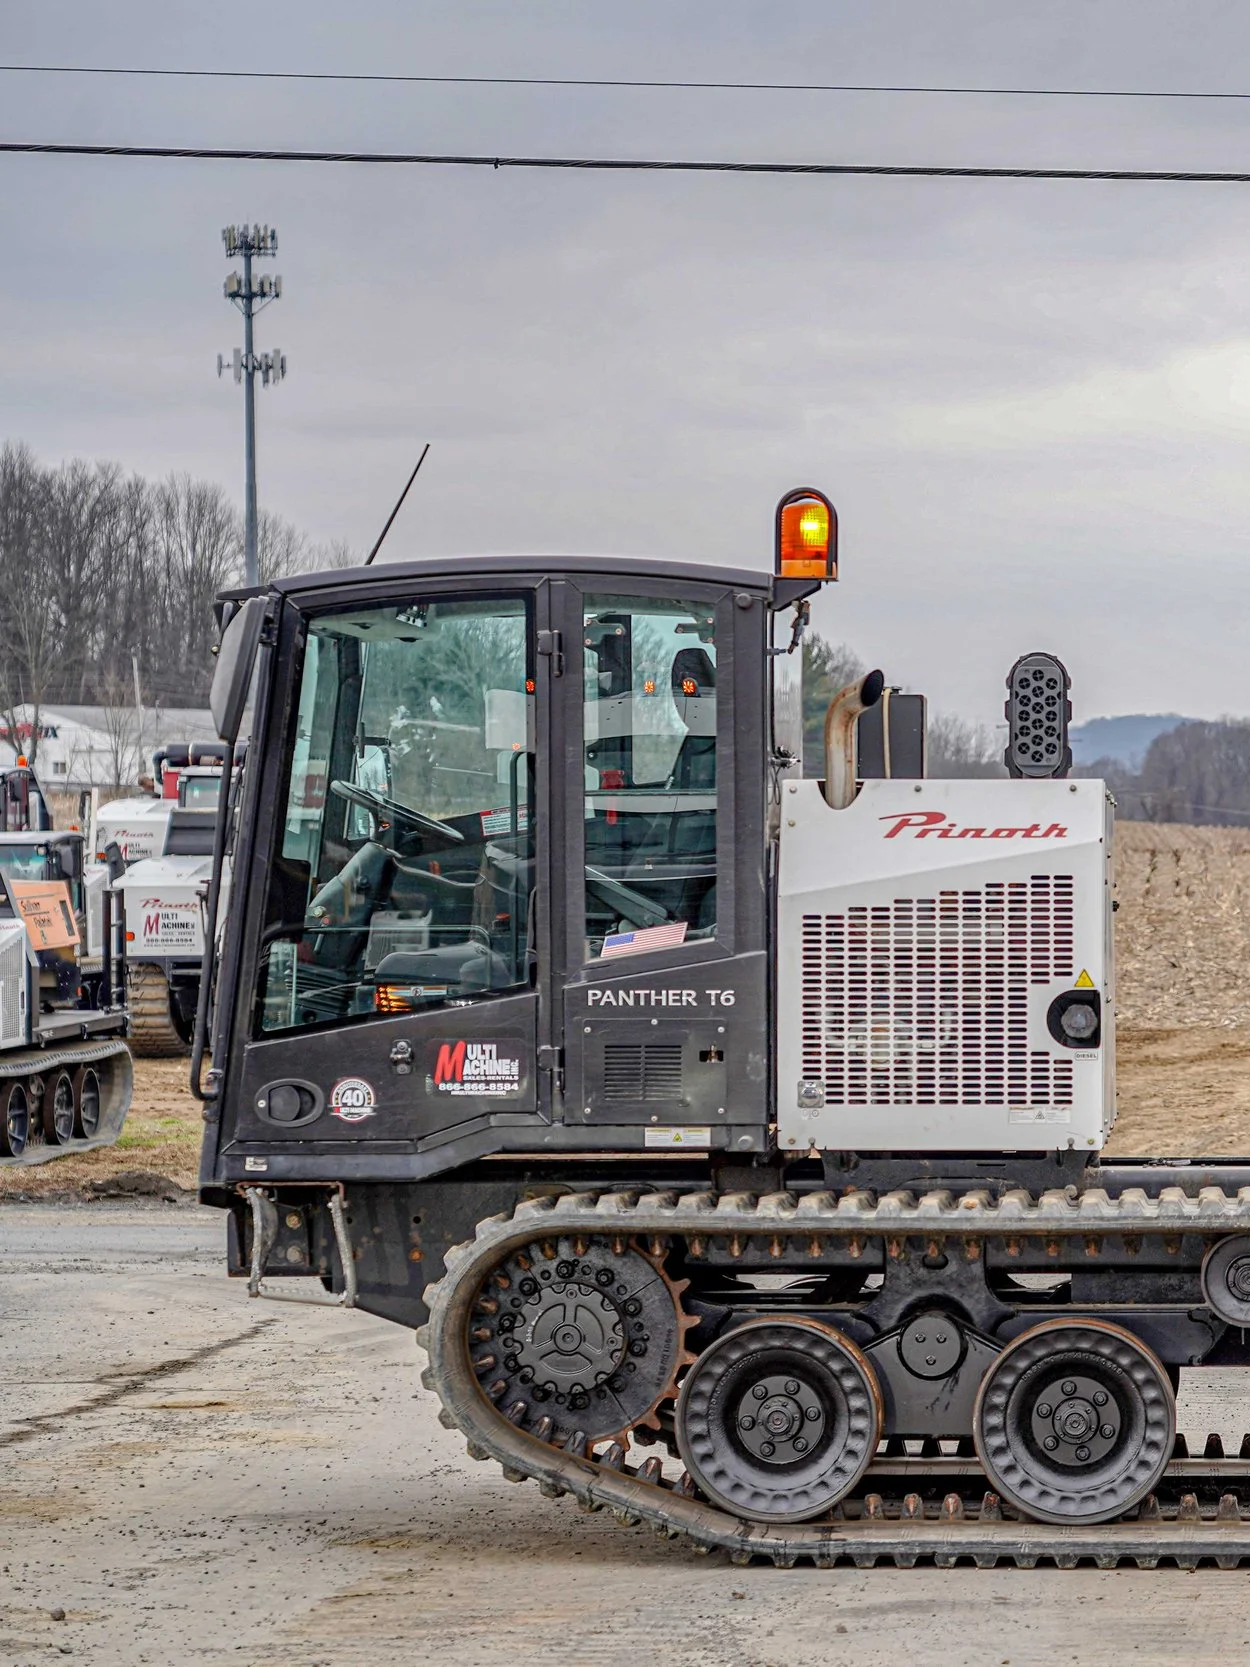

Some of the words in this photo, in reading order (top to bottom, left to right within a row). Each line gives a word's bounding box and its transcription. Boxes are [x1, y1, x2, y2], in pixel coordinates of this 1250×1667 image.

[878, 811, 1068, 838] Prinoth
[587, 989, 698, 1006] PANTHER
[705, 989, 736, 1006] T6
[439, 1082, 519, 1091] 866-866-8584
[341, 1089, 365, 1106] 40
